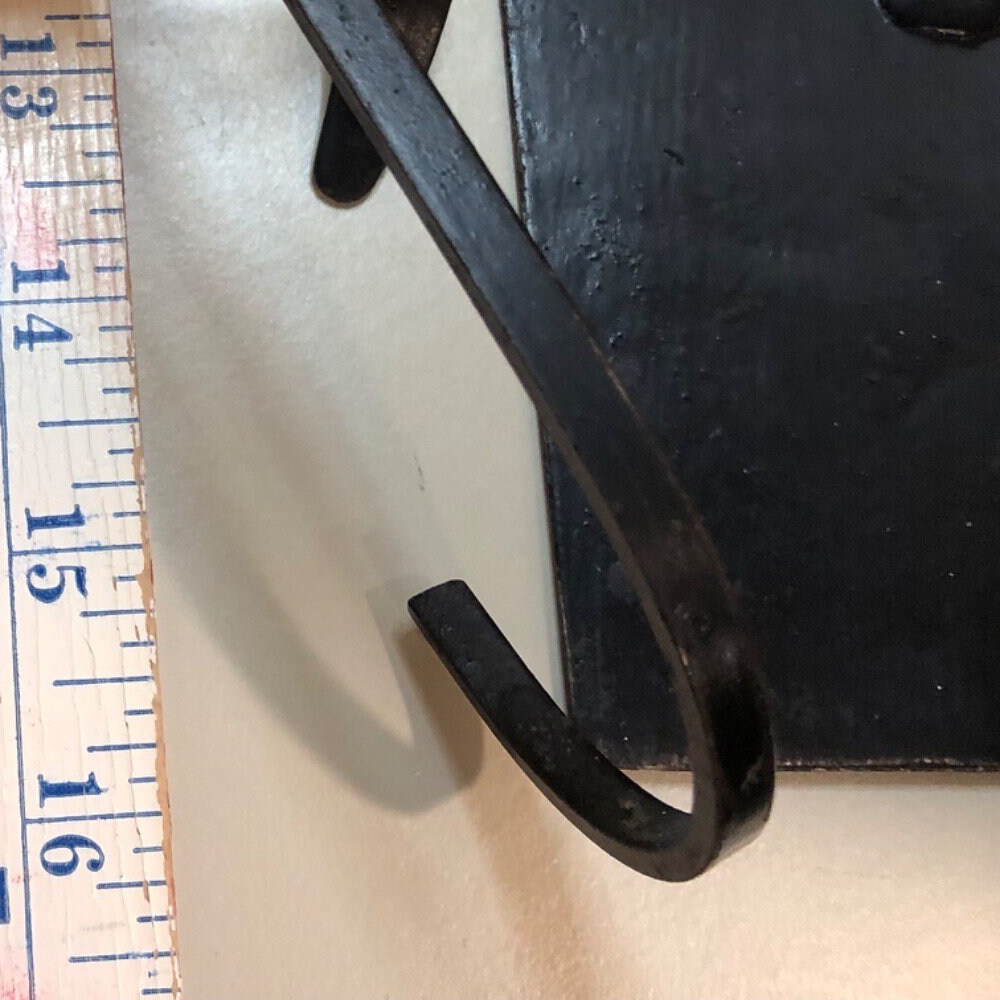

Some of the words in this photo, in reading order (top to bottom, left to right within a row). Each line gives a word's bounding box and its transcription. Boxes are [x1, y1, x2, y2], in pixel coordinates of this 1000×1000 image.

[0, 32, 58, 119] 13
[10, 259, 74, 352] 14
[25, 503, 89, 604] 15
[36, 771, 106, 877] 16
